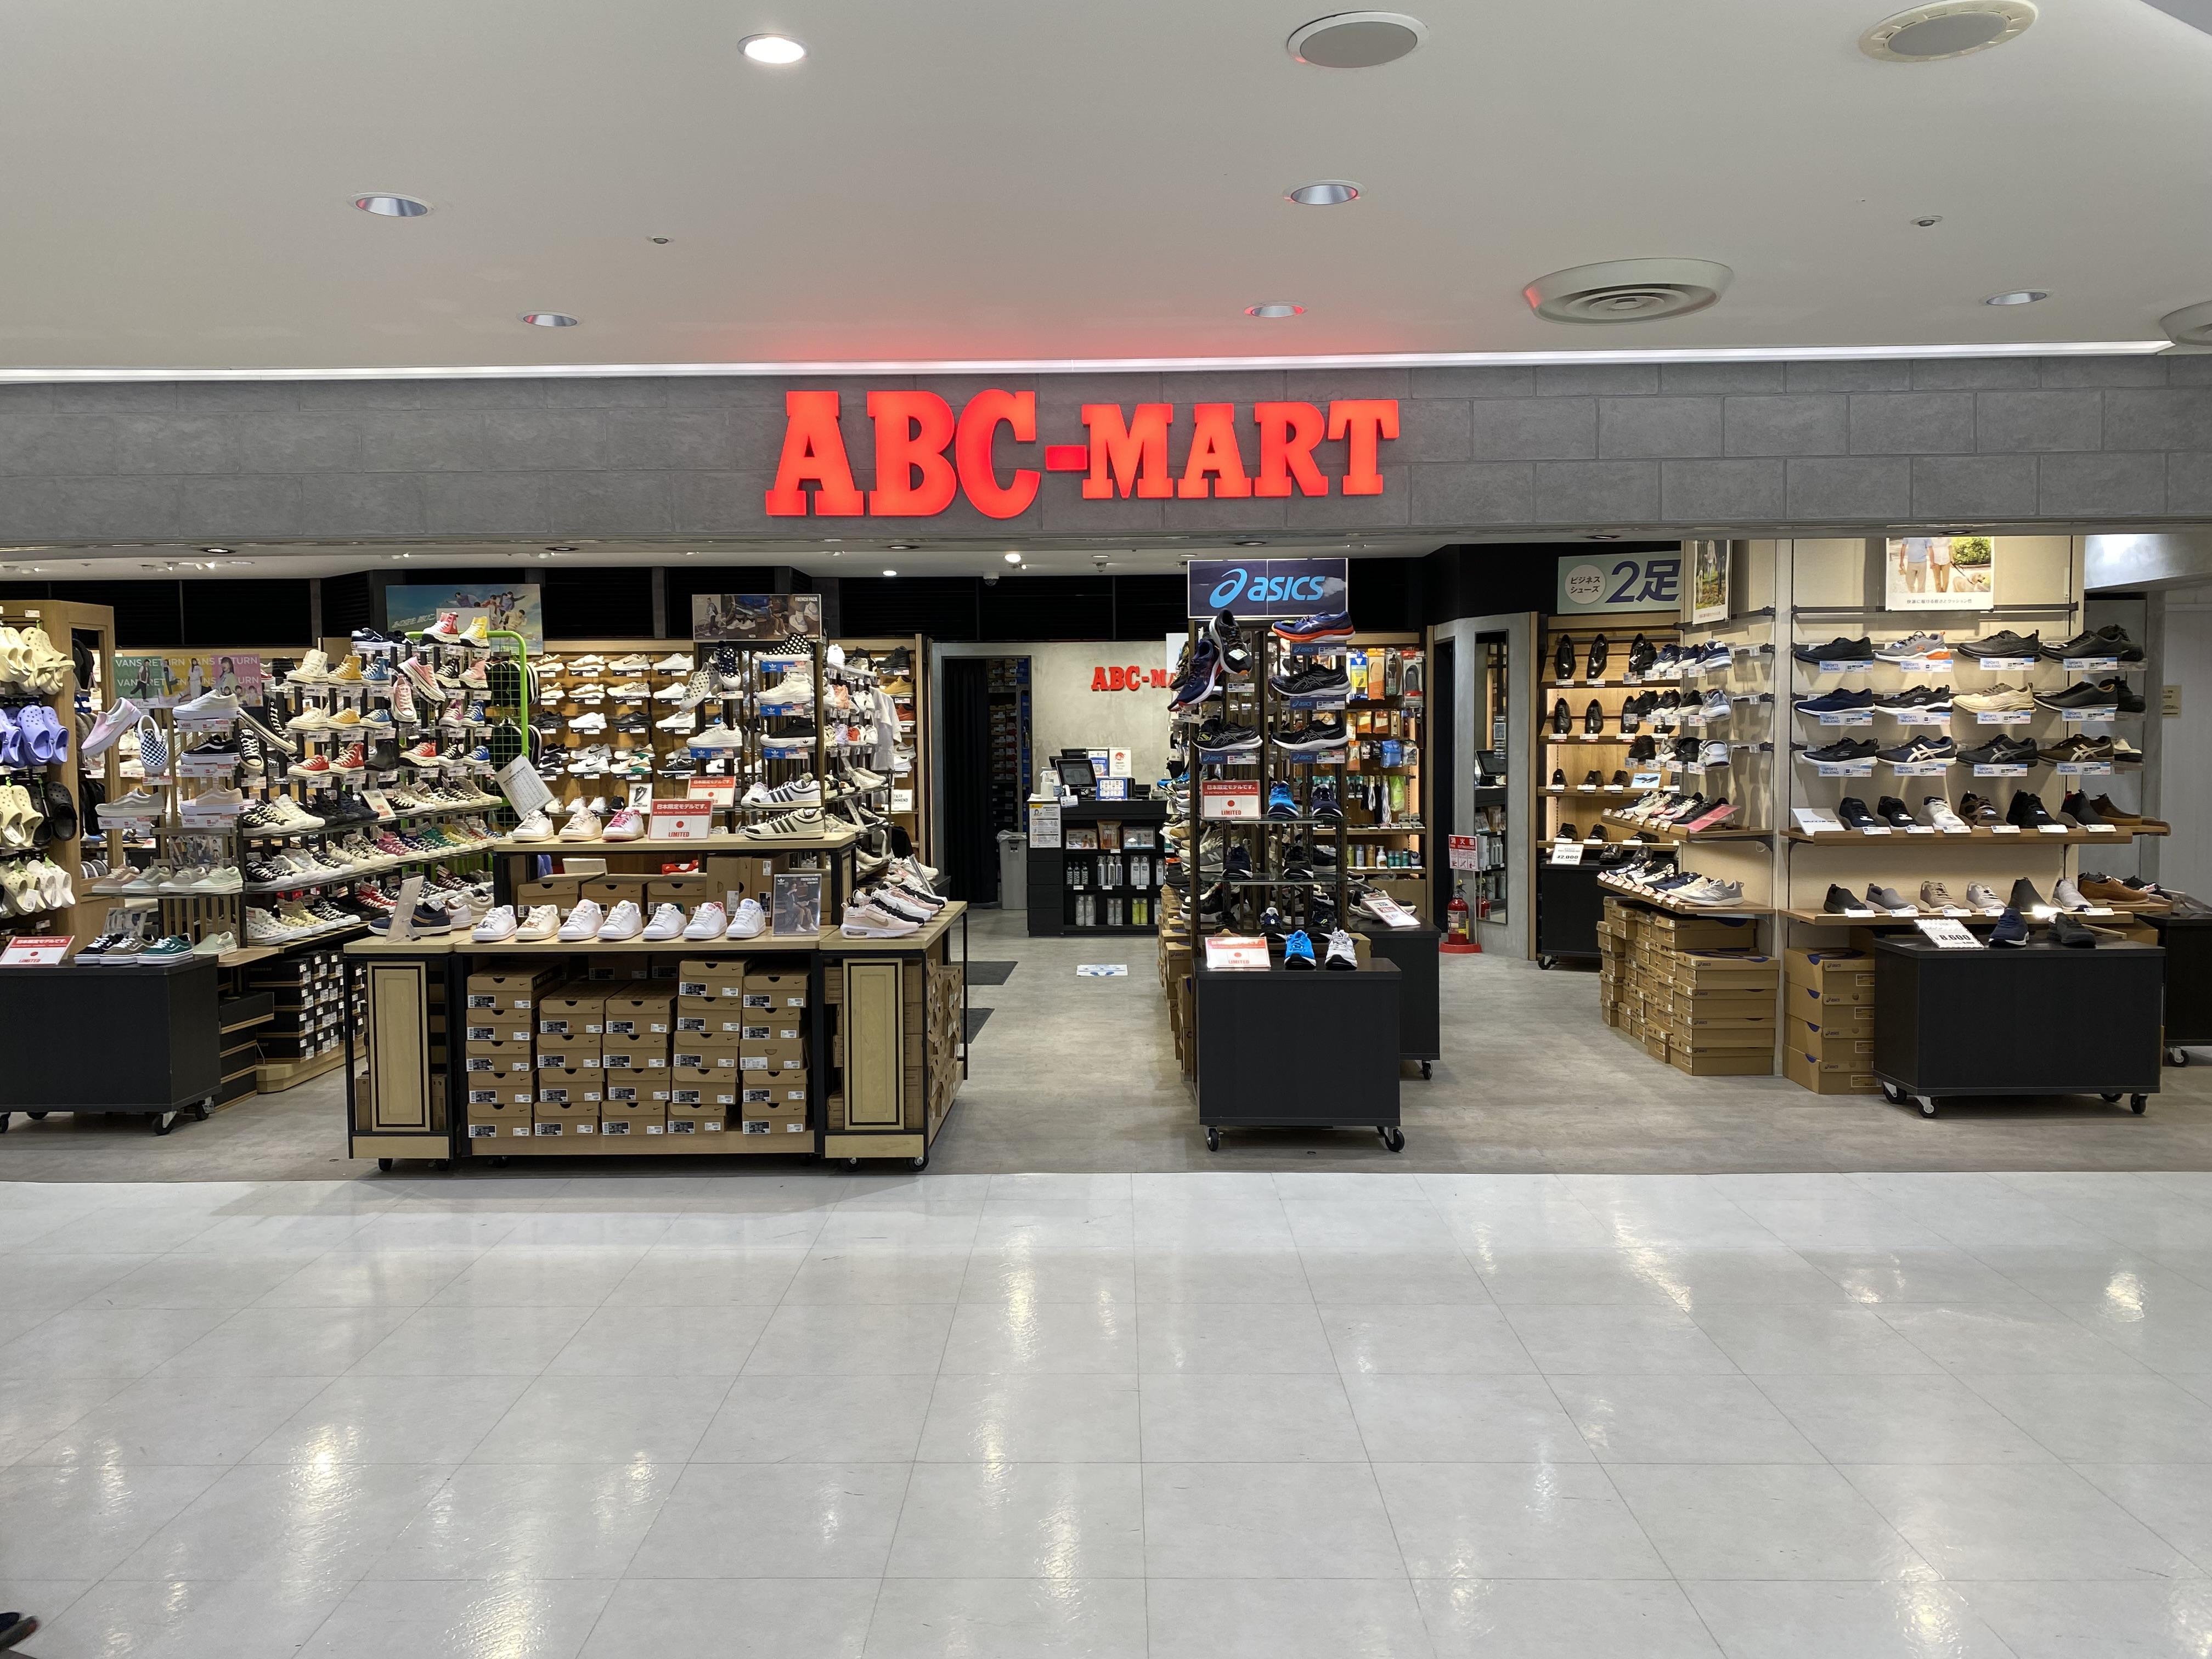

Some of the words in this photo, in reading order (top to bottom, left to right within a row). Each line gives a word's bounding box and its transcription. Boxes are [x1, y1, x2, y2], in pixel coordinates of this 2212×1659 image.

[765, 388, 1400, 518] ABC-MART
[1247, 576, 1325, 601] asics
[1570, 585, 1600, 594] シューズ
[1605, 559, 1681, 603] 2足
[116, 659, 142, 667] VANS
